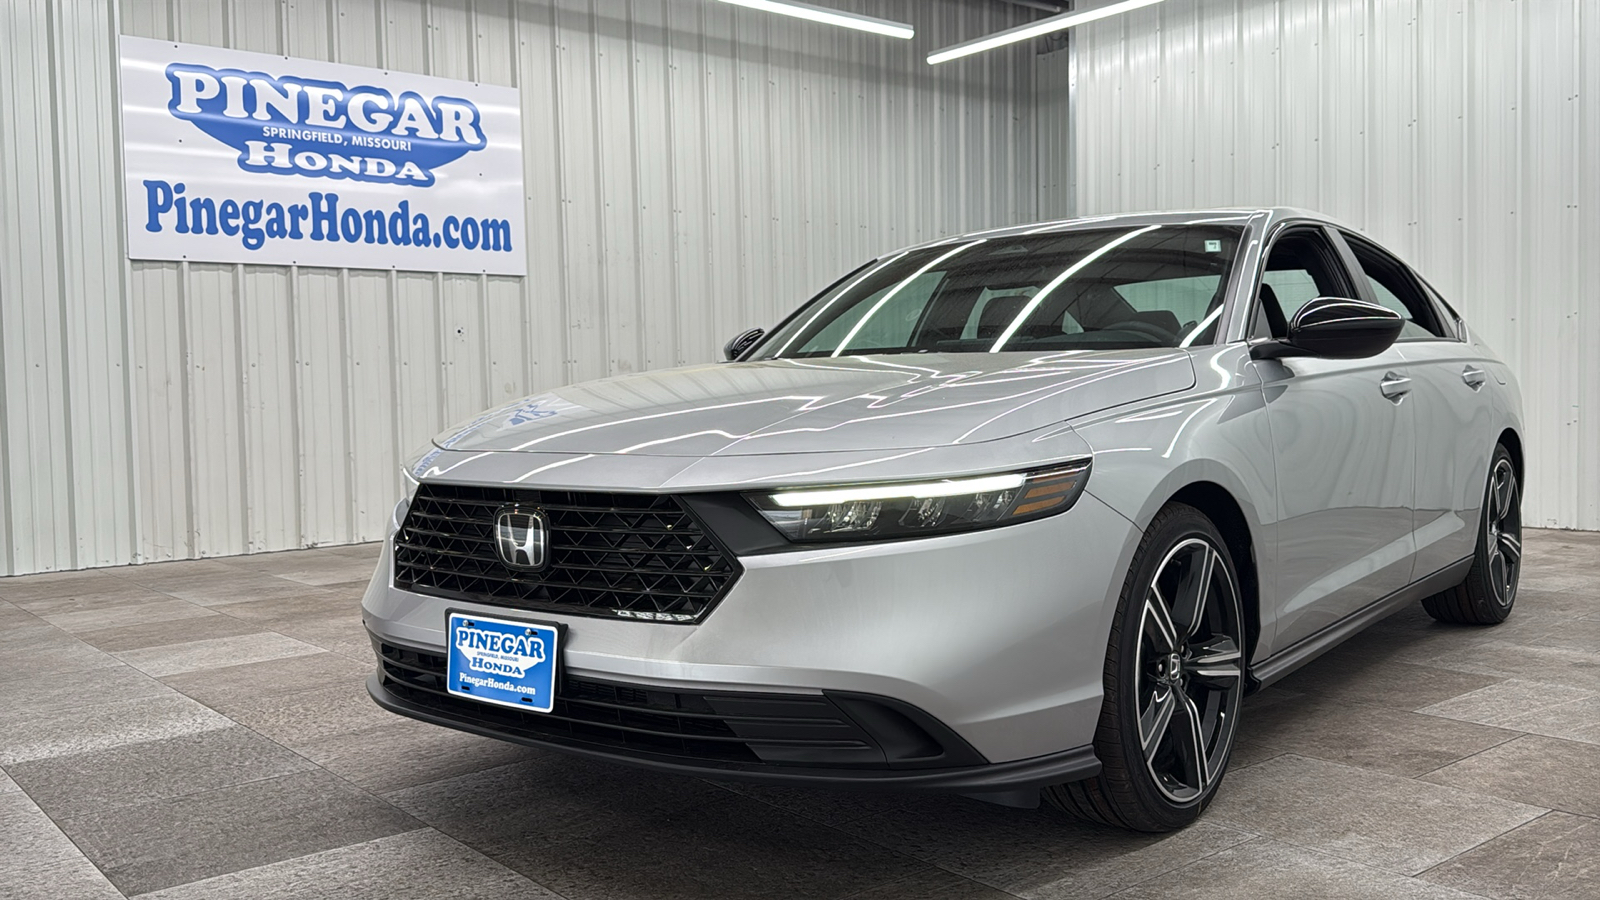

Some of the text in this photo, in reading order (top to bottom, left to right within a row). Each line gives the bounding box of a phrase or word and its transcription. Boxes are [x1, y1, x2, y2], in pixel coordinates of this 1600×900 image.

[173, 69, 482, 146] PINEGAR
[262, 126, 412, 152] SPRINGFIELD, MISSOURI
[244, 140, 429, 181] HONDA
[143, 179, 513, 252] PinegarHonda.com
[458, 629, 544, 660] PINEGAR
[471, 656, 523, 675] HONDA
[459, 672, 537, 695] PinegarHonda.com
